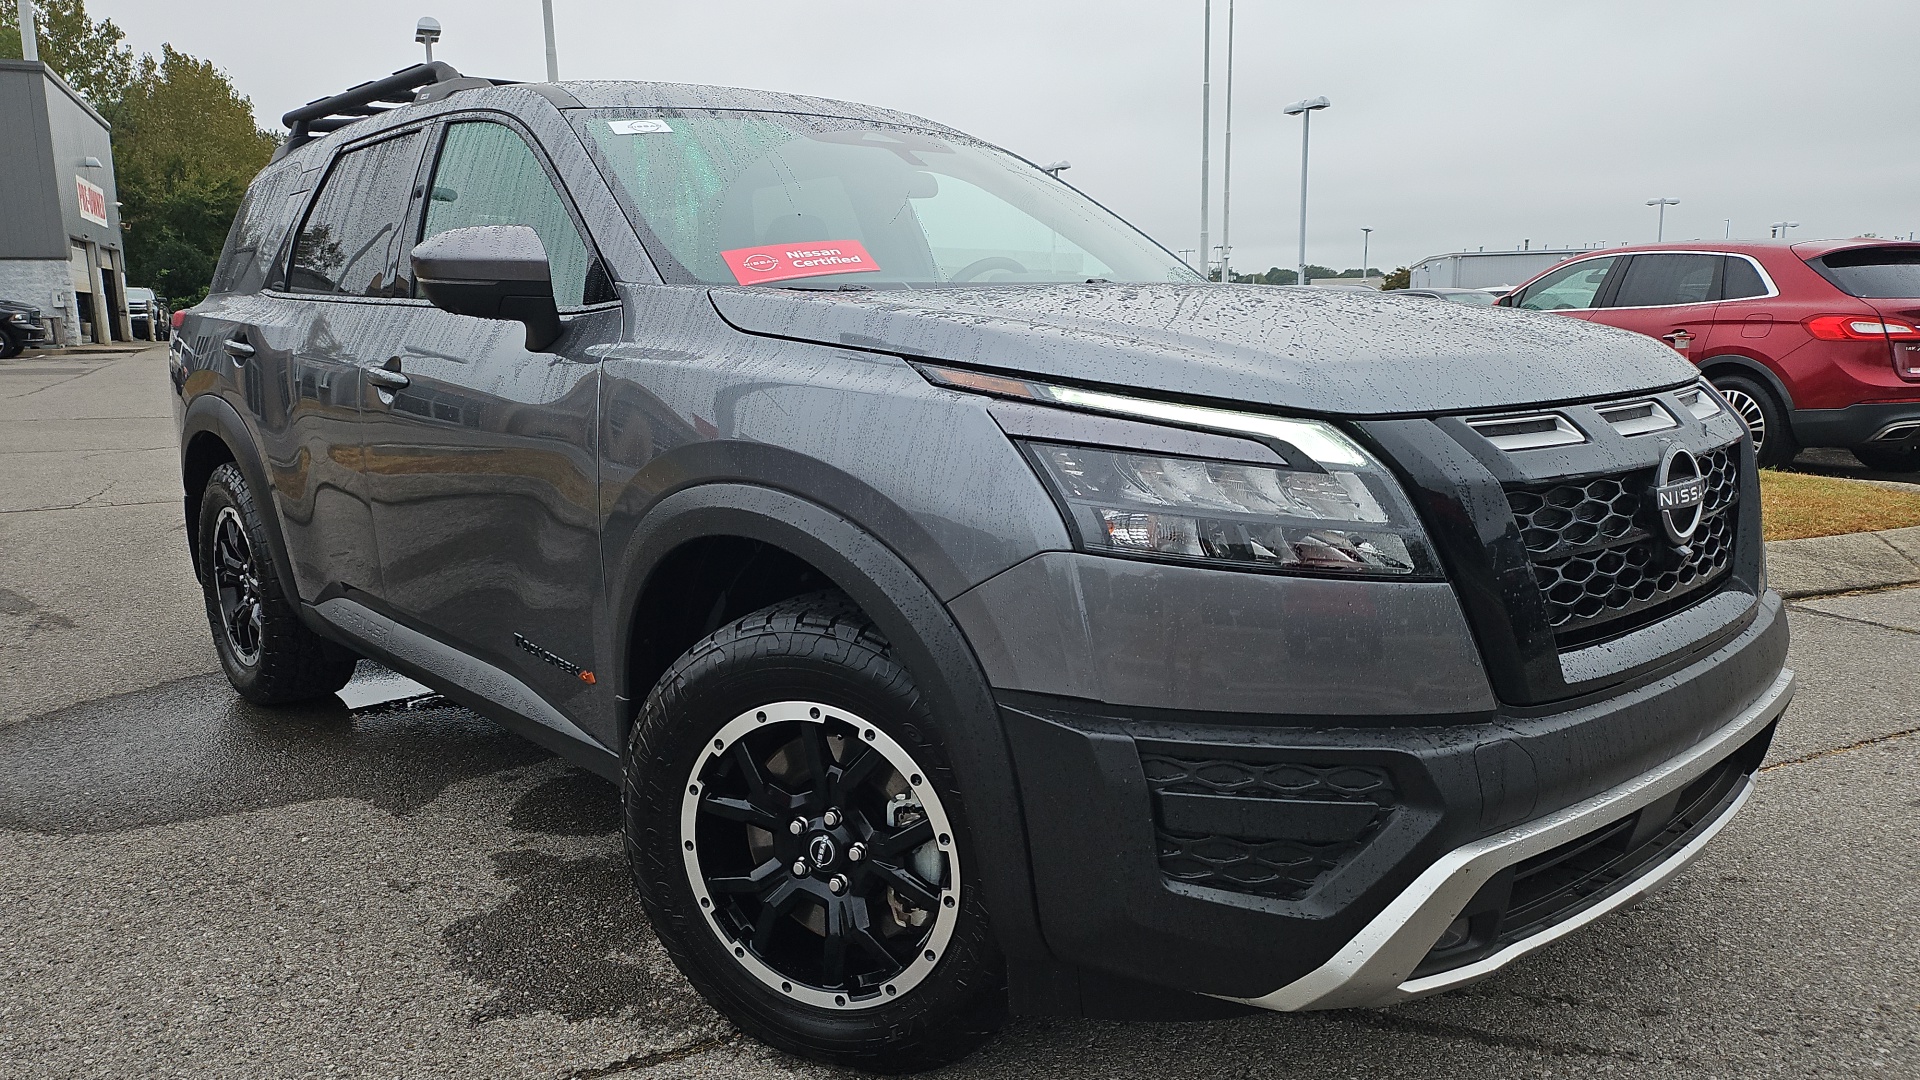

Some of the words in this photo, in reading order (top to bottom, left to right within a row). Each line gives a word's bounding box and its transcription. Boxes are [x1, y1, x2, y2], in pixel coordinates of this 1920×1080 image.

[785, 248, 841, 259] Nissan
[743, 258, 779, 268] NISSAN
[792, 255, 862, 268] Certified
[1659, 485, 1703, 507] NISSA
[513, 632, 543, 659] ROCK
[544, 650, 581, 676] CREEK
